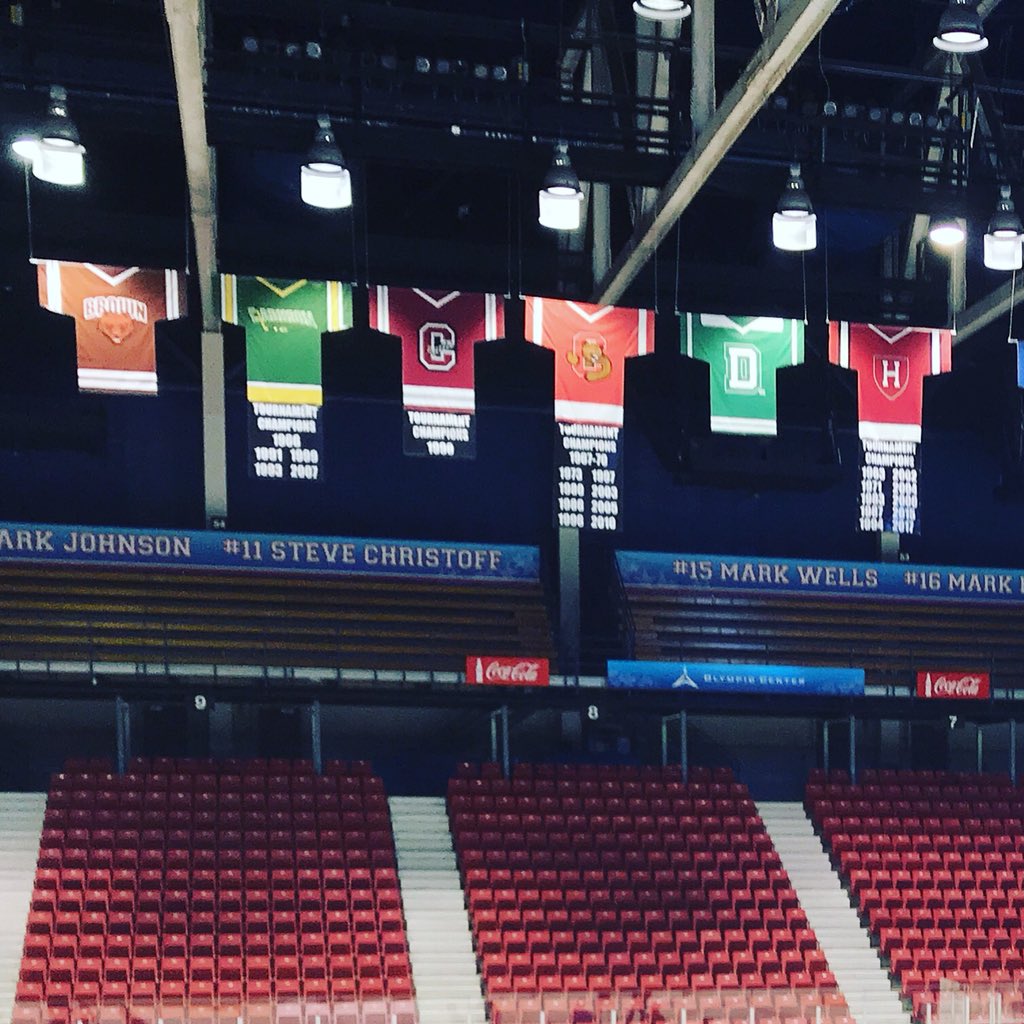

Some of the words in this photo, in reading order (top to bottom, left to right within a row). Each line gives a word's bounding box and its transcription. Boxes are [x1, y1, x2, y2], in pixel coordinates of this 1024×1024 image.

[724, 342, 763, 395] D
[881, 359, 901, 388] H
[257, 417, 316, 433] CHAMPIONS
[408, 411, 470, 428] TOURNAMENT
[413, 425, 469, 441] CHAMPIONS
[559, 423, 619, 440] TOURNAMENT
[563, 437, 616, 453] CHAMPIONS
[865, 452, 914, 468] CHAMPIONS
[64, 532, 191, 557] JOHNSON
[223, 538, 263, 560] #11
[271, 542, 356, 564] STEVE
[364, 545, 502, 571] CHRISTOFF
[673, 559, 712, 580] #15
[720, 563, 789, 585] MARK
[796, 566, 879, 588] WELLS
[904, 571, 941, 592] #16
[948, 573, 1013, 595] MARK
[703, 673, 756, 684] OLYMPIC
[760, 675, 806, 685] CENTER
[194, 694, 207, 710] 9
[587, 704, 599, 720] 8
[948, 715, 958, 730] 7
